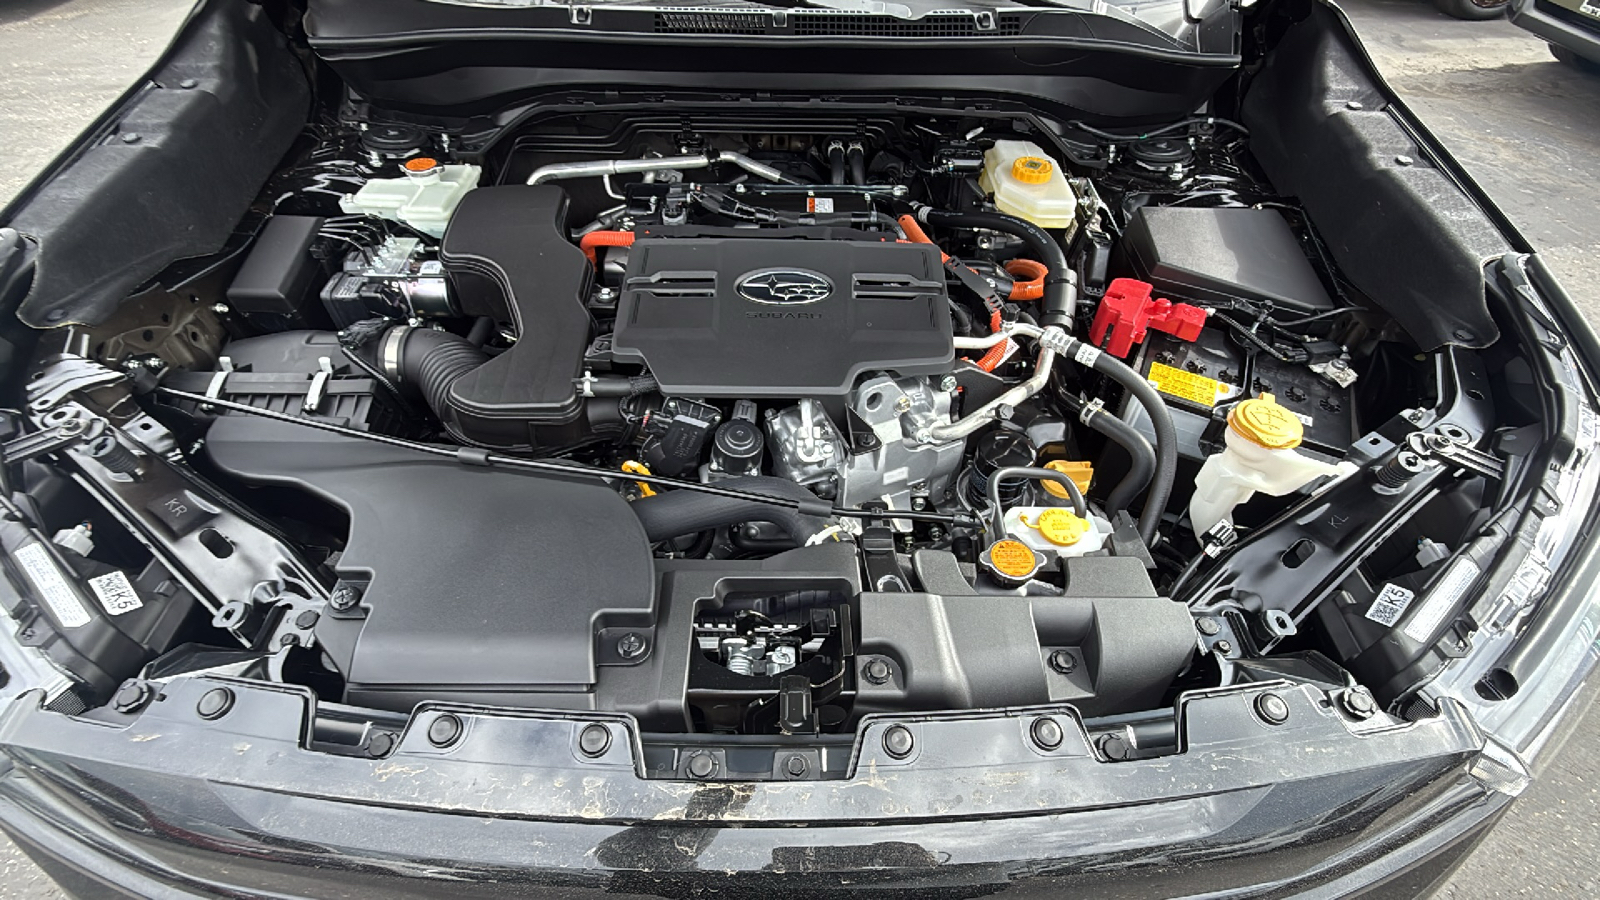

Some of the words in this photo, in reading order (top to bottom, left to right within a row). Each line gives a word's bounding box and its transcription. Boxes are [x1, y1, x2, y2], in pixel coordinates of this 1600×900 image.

[745, 311, 822, 319] SUBARU
[164, 498, 188, 517] KR
[1328, 514, 1349, 529] KL
[111, 591, 134, 610] K5
[1385, 587, 1405, 606] K5
